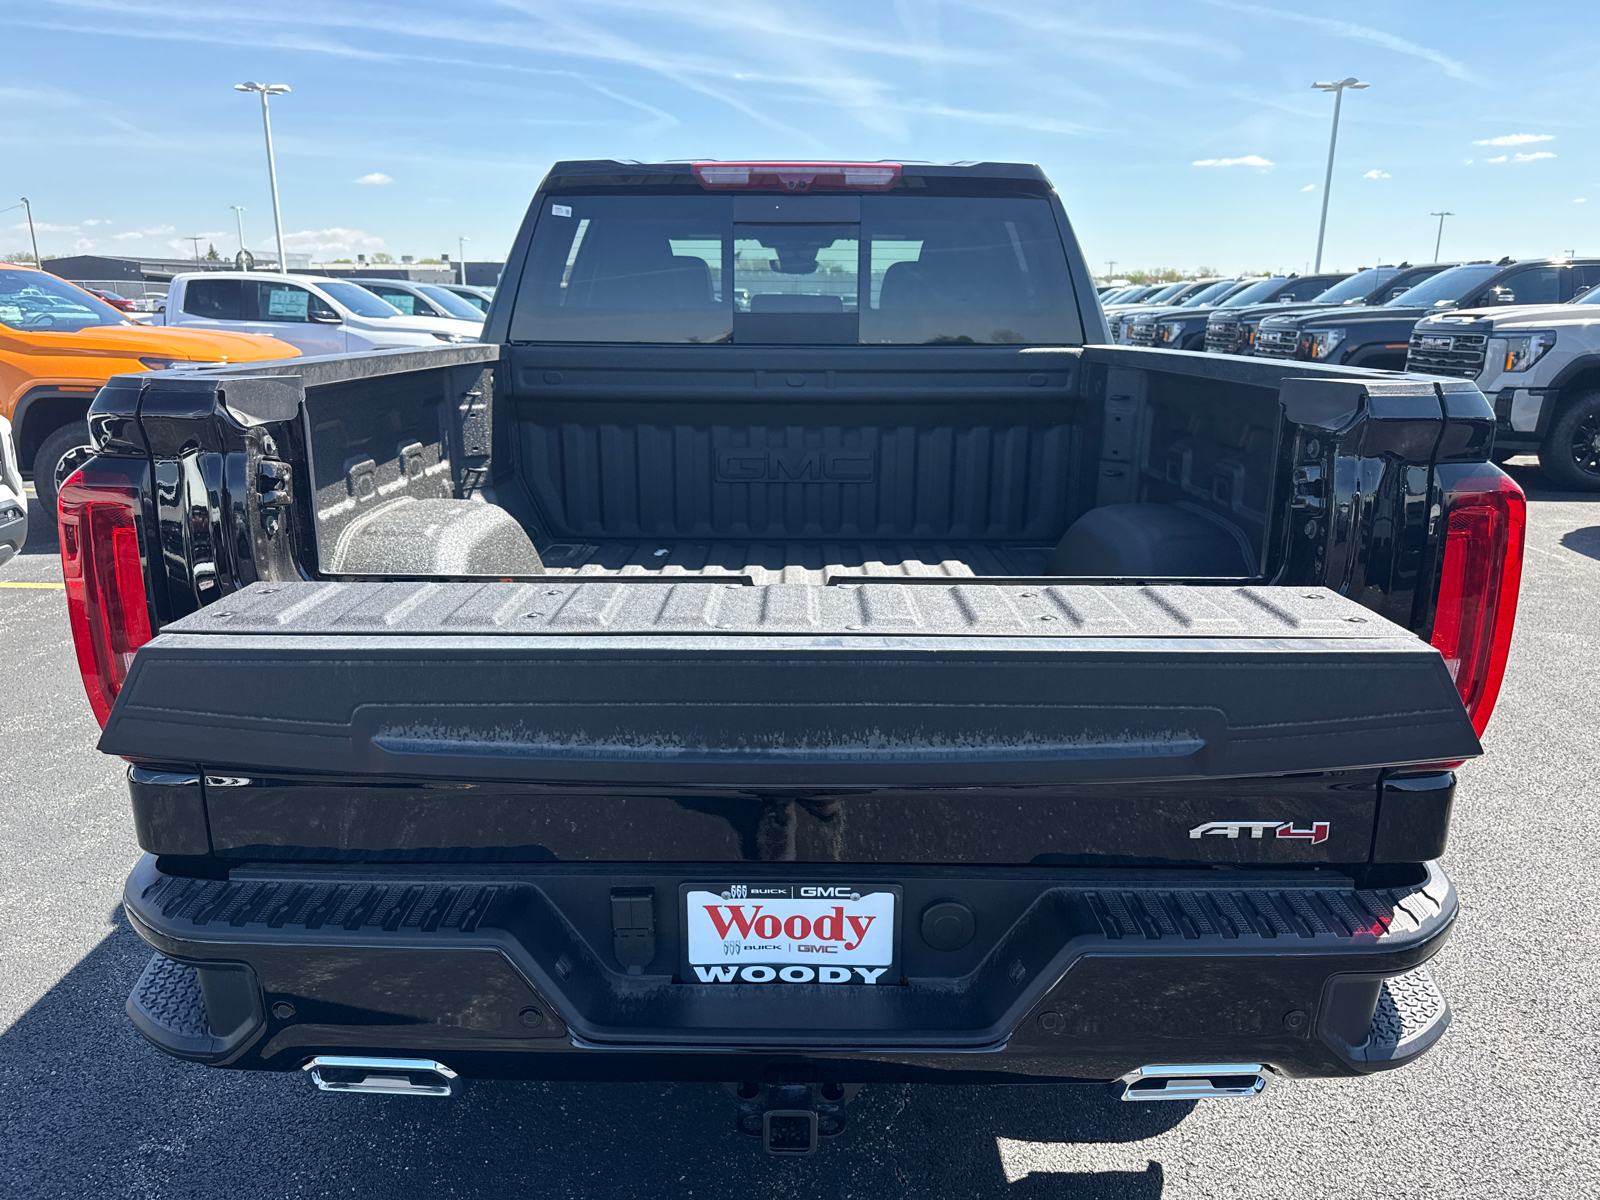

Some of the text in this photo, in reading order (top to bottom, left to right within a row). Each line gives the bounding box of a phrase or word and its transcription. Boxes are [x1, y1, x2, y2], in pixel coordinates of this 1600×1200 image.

[718, 452, 872, 480] GMC
[1189, 821, 1331, 845] AT4
[800, 886, 851, 897] GMC
[702, 905, 877, 951] Woody
[797, 944, 838, 954] GMC
[693, 965, 888, 985] WOODY
